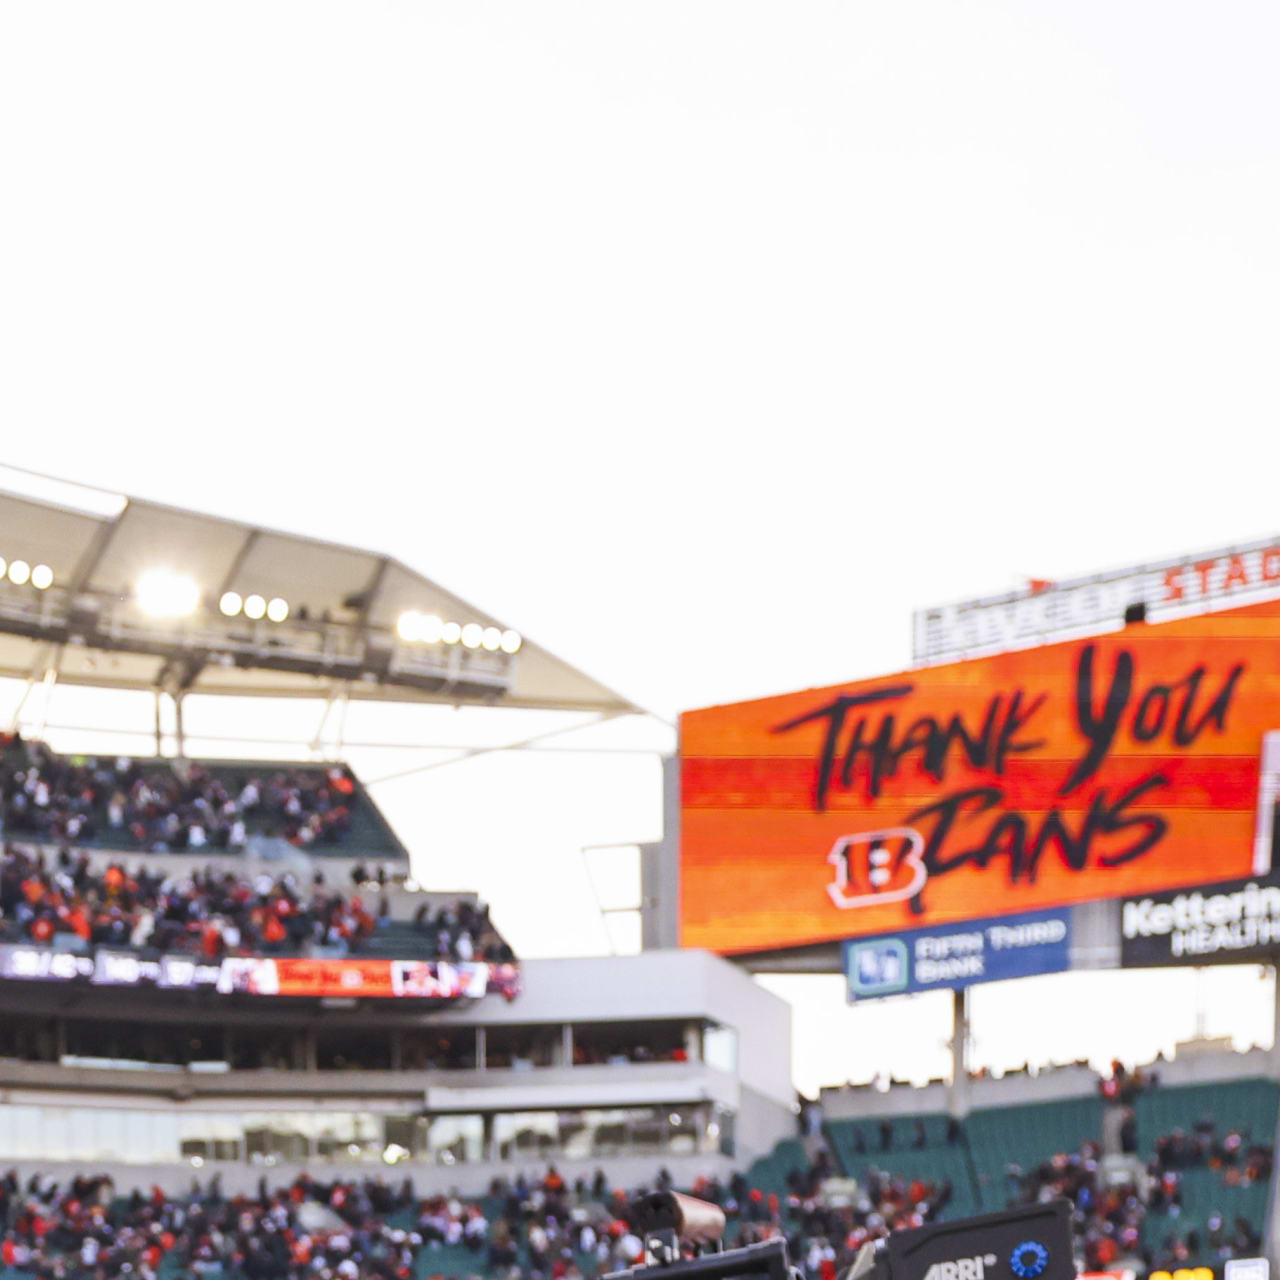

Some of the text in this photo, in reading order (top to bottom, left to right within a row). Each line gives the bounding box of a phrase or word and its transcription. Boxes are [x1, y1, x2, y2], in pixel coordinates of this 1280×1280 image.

[770, 644, 1244, 812] THANK YOU
[908, 773, 1168, 913] FANS
[985, 919, 1067, 950] THIRD
